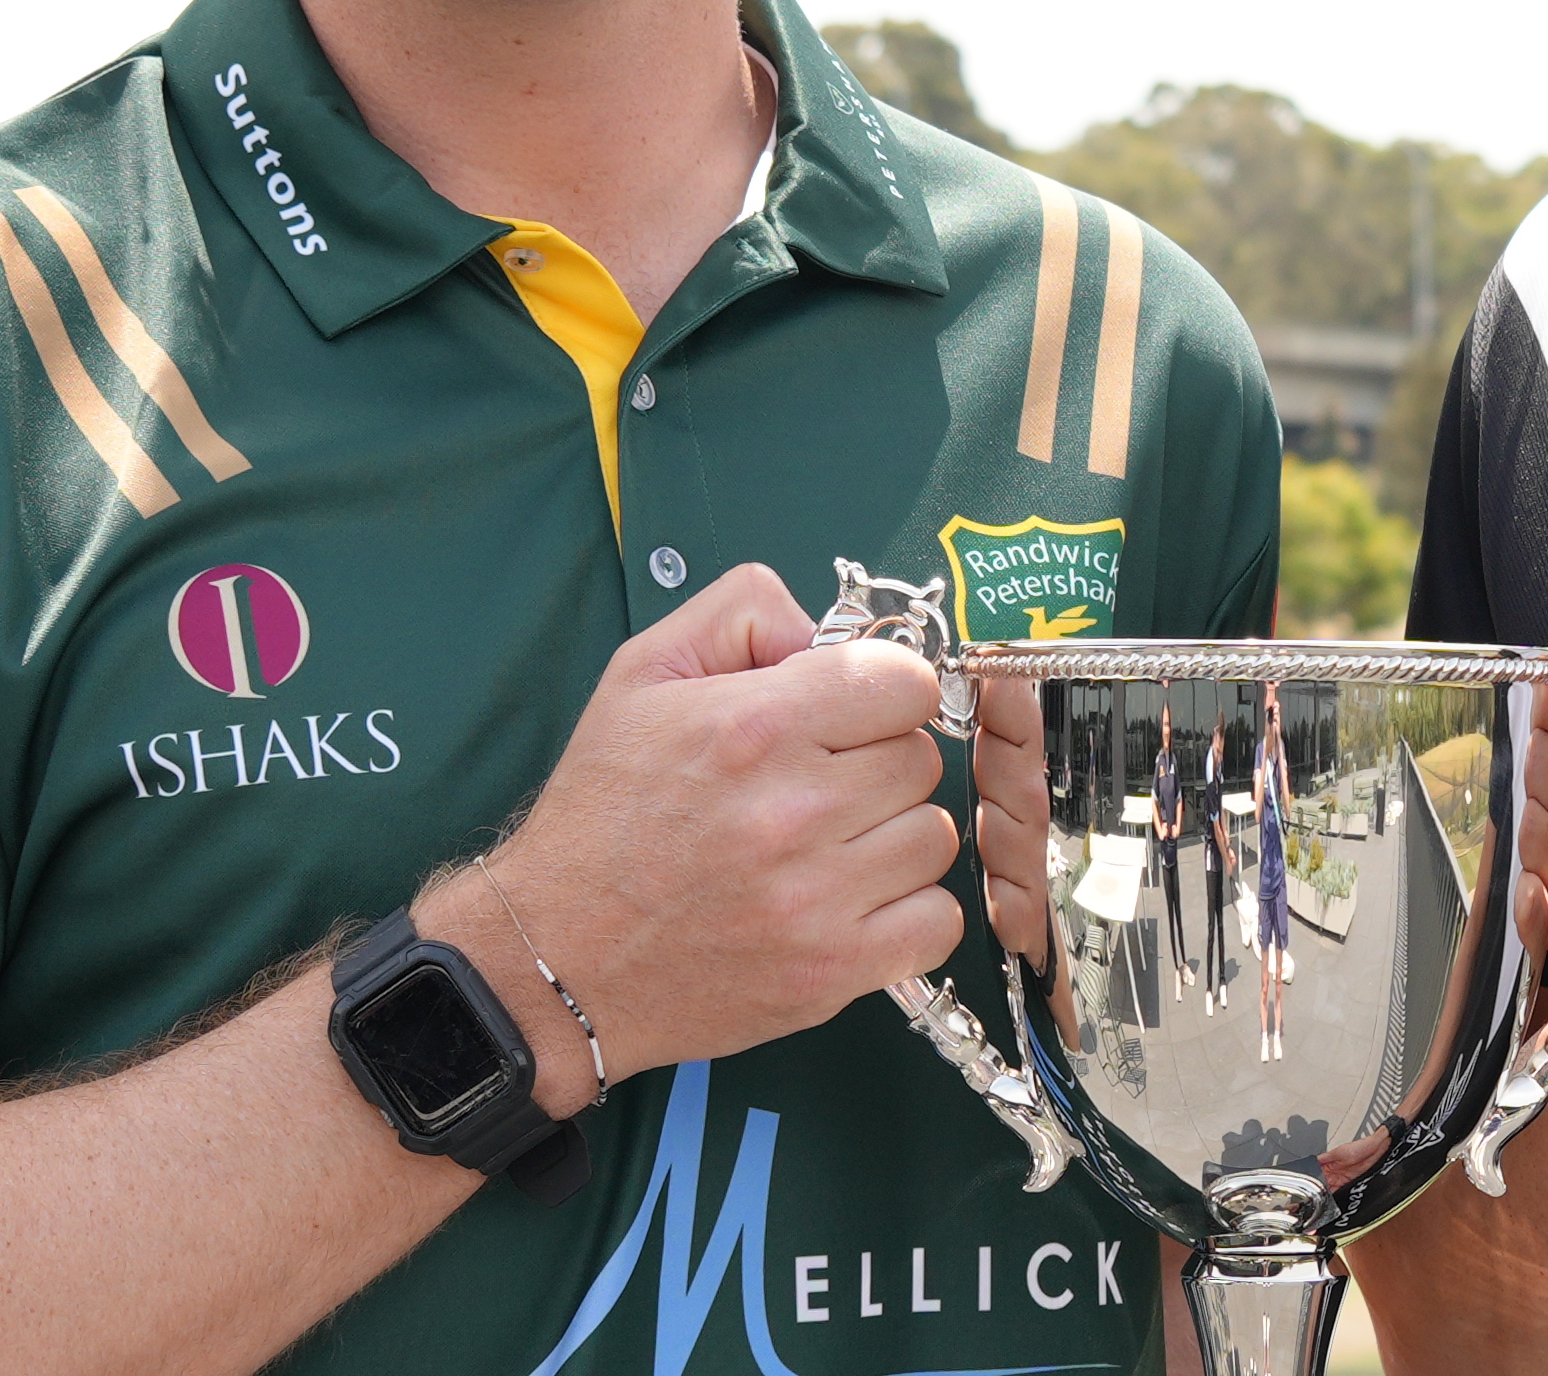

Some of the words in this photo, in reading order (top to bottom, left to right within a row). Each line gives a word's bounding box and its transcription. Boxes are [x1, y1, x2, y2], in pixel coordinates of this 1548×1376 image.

[215, 63, 328, 256] Suttons
[965, 535, 1120, 586] Randwick
[118, 709, 401, 799] ISHAKS
